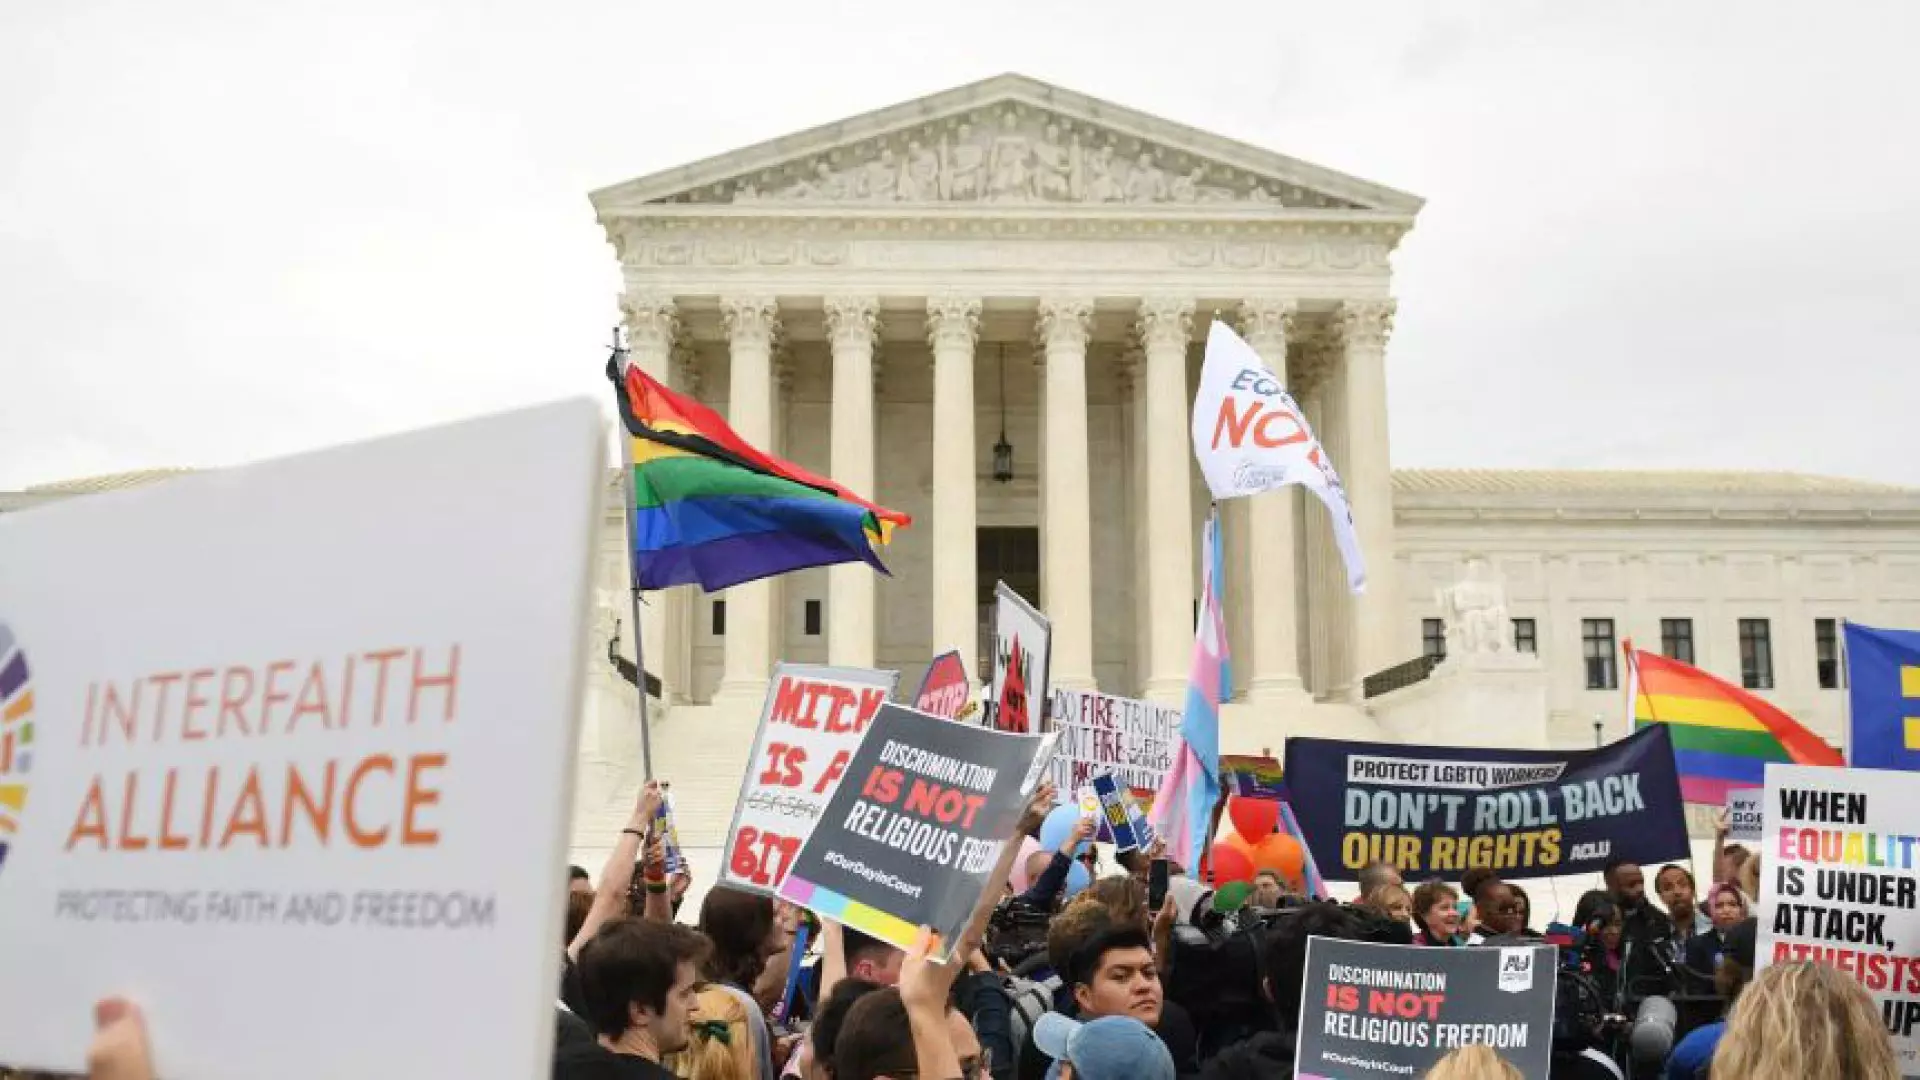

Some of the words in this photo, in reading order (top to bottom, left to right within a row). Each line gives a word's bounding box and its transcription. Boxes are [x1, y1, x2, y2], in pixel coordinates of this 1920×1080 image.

[80, 644, 462, 747] INTERFAITH
[759, 743, 807, 787] IS
[879, 739, 997, 793] DISCRIMINATION
[1353, 759, 1430, 782] PROTECT
[1434, 764, 1488, 785] LGBTQ
[64, 753, 448, 852] ALLIANCE
[863, 765, 904, 804] IS
[904, 777, 988, 830] NOT
[1345, 787, 1467, 832] DON'T
[1473, 787, 1559, 832] ROLL
[1561, 773, 1645, 822] BACK
[1780, 788, 1867, 824] WHEN
[844, 800, 960, 866] RELIGIOUS
[1342, 831, 1423, 870] OUR
[1430, 828, 1563, 870] RIGHTS
[1569, 840, 1611, 860] ACLU
[1779, 826, 1920, 869] EQUALIT
[55, 889, 199, 925] PROTECTING
[204, 890, 279, 924] FAITH
[282, 892, 347, 927] AND
[350, 892, 497, 929] FREEDOM
[1776, 866, 1804, 896] IS
[1817, 869, 1917, 909] UNDER
[1773, 903, 1895, 951] ATTACK,
[1329, 964, 1447, 992] DISCRIMINATION
[1326, 984, 1360, 1011] IS
[1368, 990, 1445, 1021] NOT
[1324, 1010, 1430, 1048] RELIGIOUS
[1435, 1022, 1529, 1048] FREEDOM
